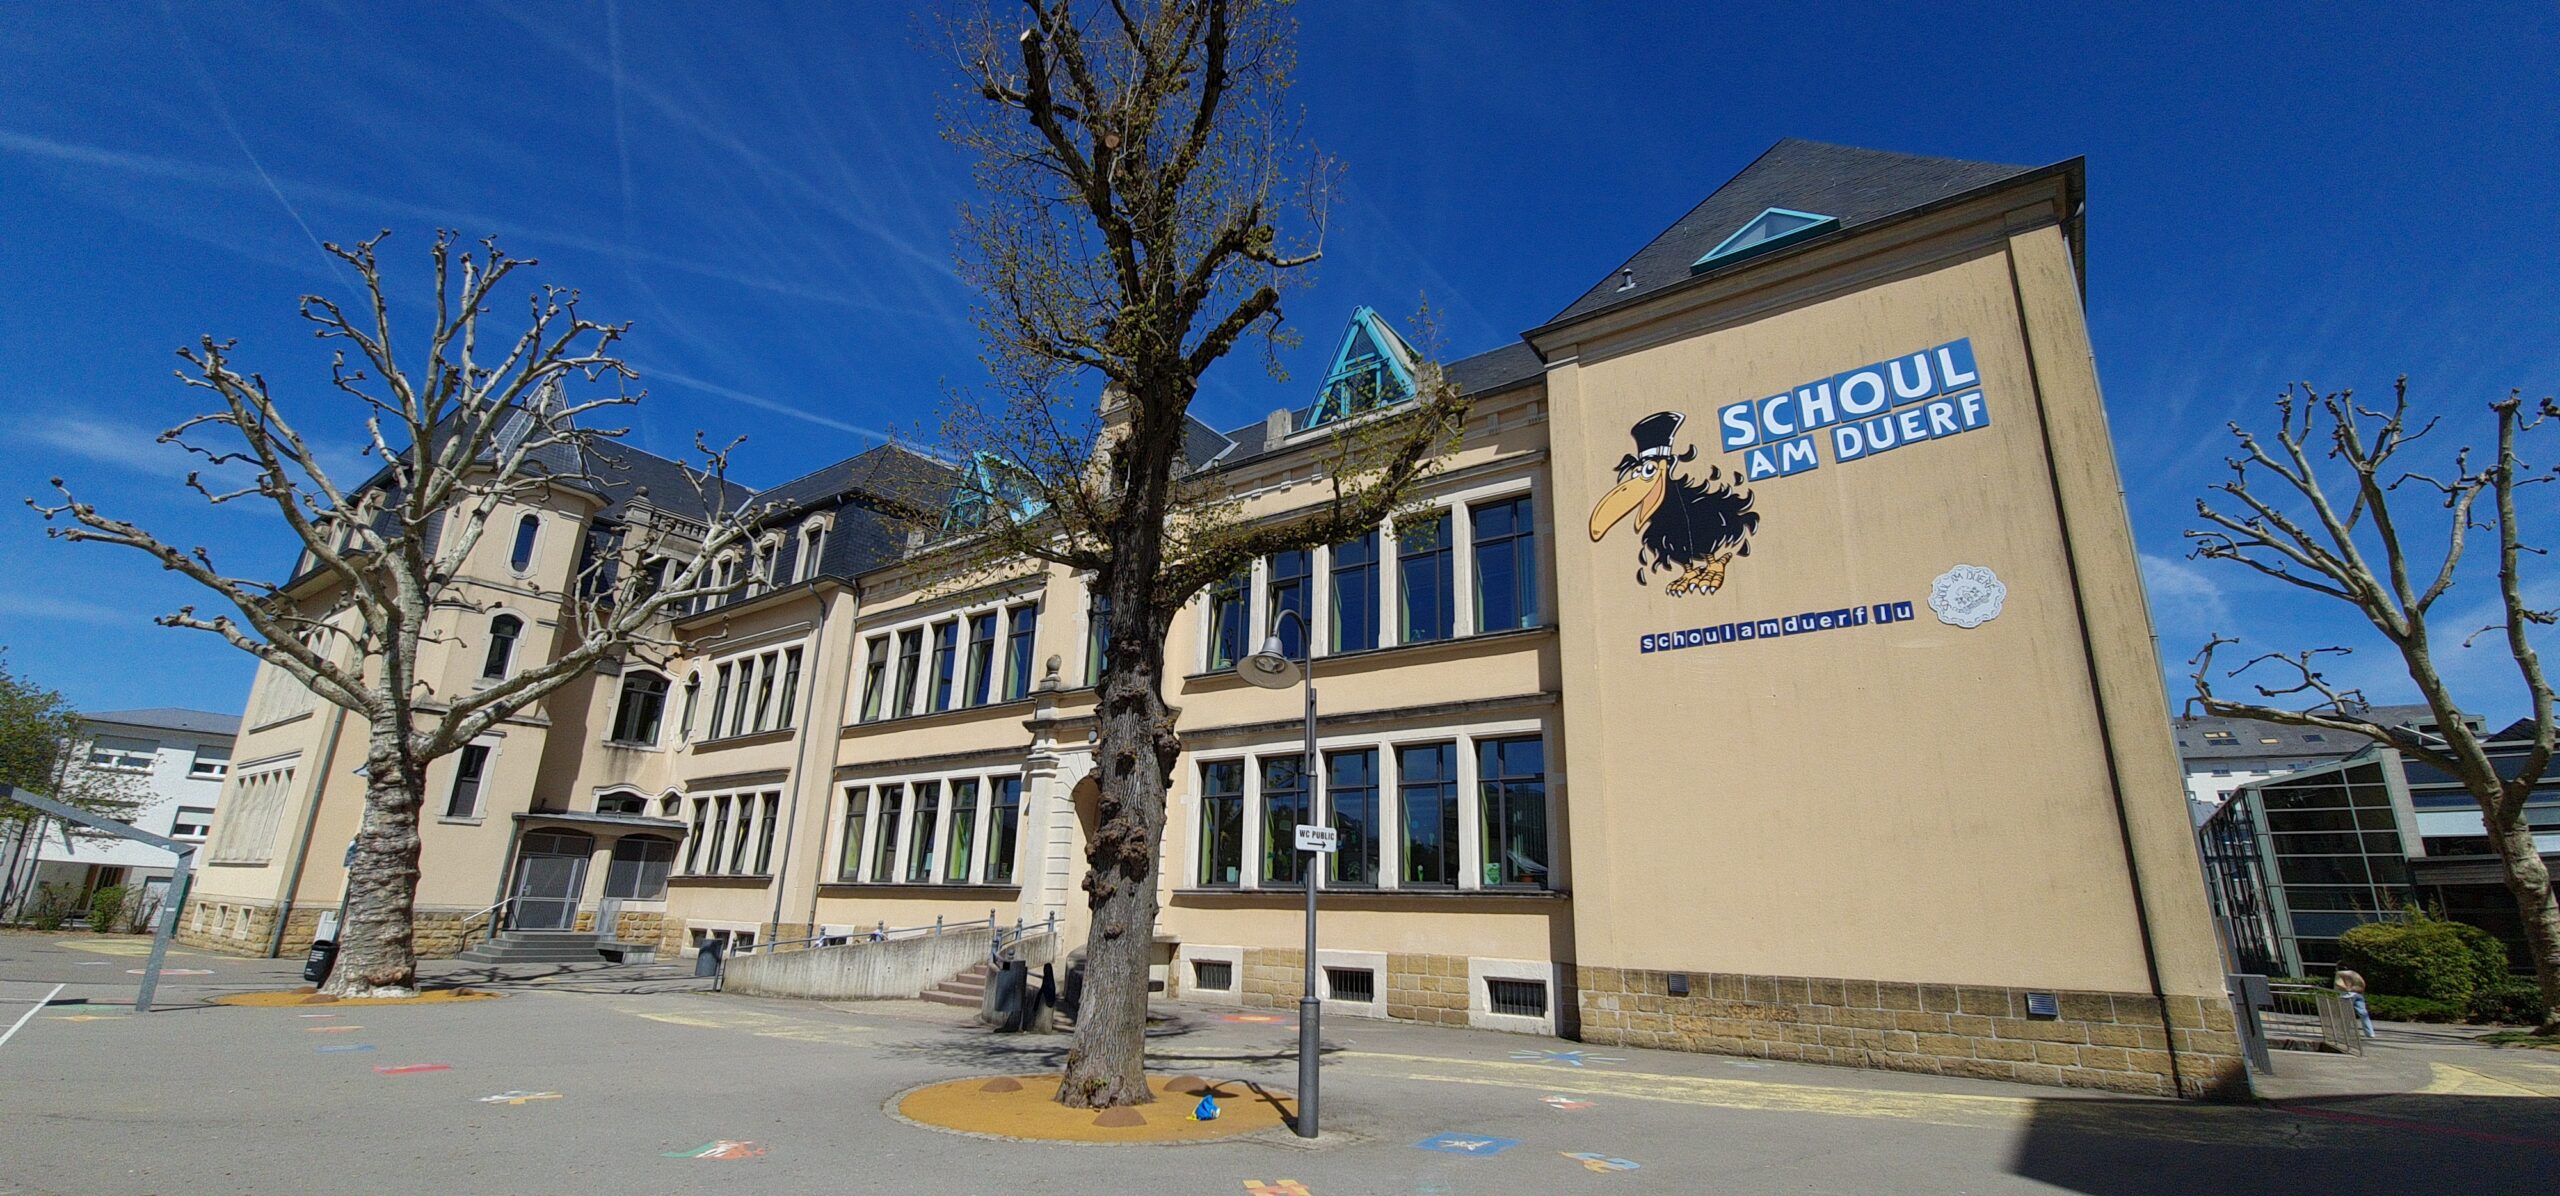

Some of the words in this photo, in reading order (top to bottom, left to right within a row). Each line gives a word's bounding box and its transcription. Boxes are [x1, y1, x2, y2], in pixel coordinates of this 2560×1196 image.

[1723, 347, 1976, 446] SCHOUL
[1750, 439, 1817, 478] AM
[1836, 392, 1981, 459] DUERF
[1299, 829, 1310, 838] WC
[1311, 831, 1334, 841] PUBLIC
